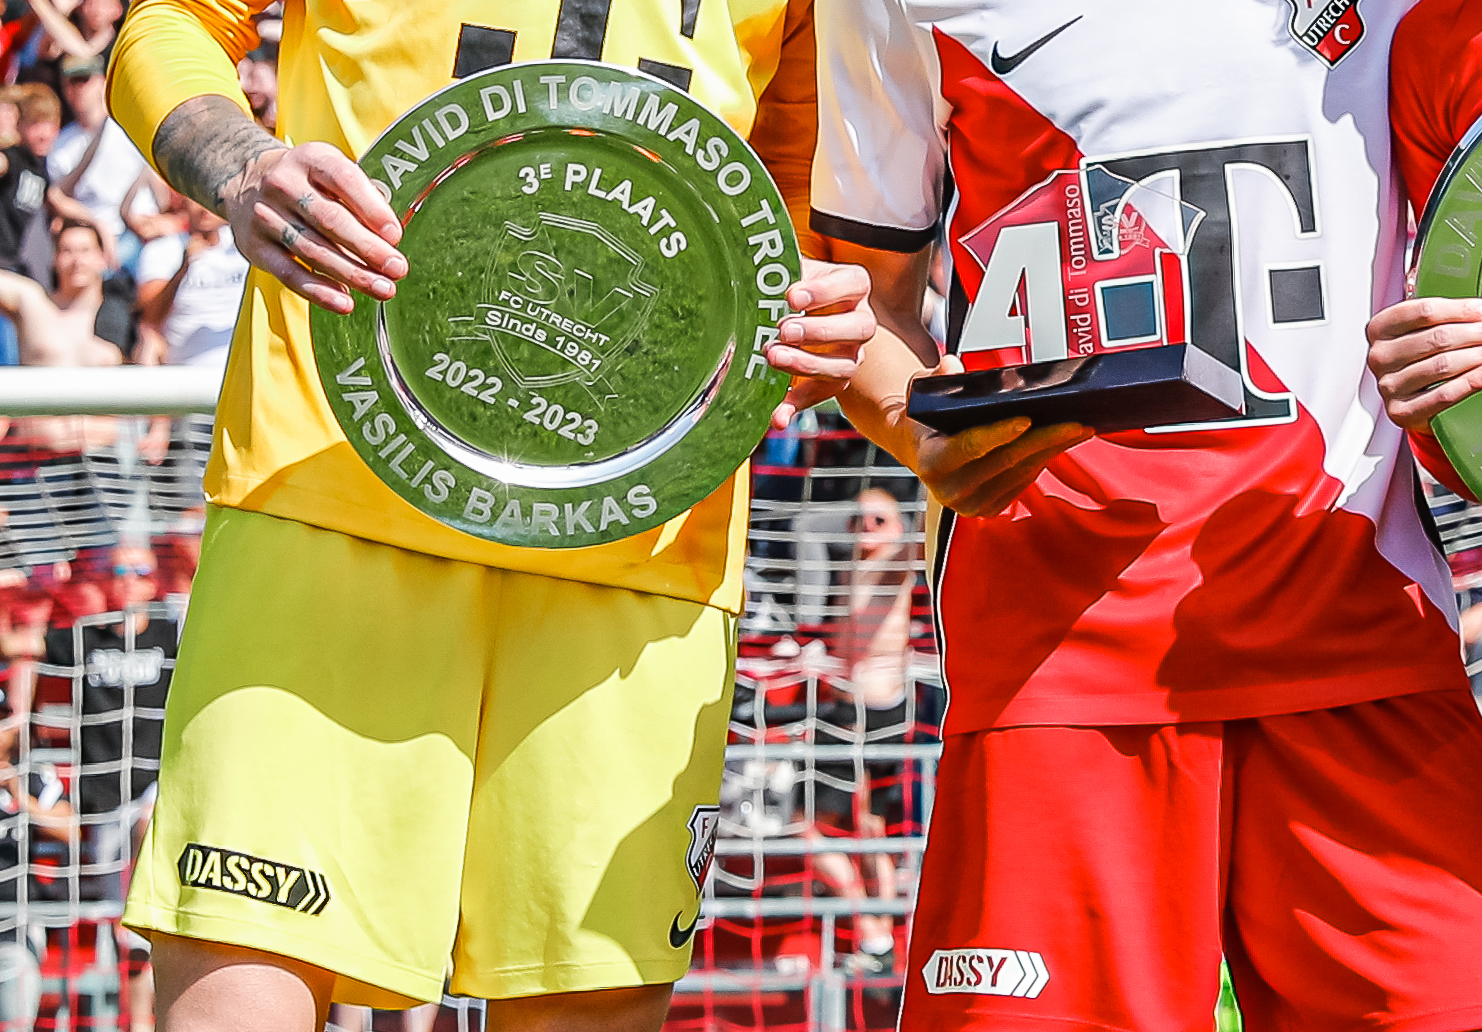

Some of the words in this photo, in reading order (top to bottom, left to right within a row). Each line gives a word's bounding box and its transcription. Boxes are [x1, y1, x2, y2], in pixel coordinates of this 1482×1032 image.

[1334, 24, 1351, 45] C
[479, 80, 527, 123] DI
[540, 74, 753, 197] TOMMASO
[564, 163, 688, 260] PLAATS
[1065, 184, 1087, 281] Tommaso
[498, 290, 524, 309] FC
[526, 302, 611, 347] UTRECHT
[1068, 287, 1090, 307] di
[484, 310, 548, 342] Sinds
[555, 336, 603, 373] 1981
[1070, 313, 1094, 357] avid
[424, 352, 504, 407] 2022
[523, 393, 600, 448] 2023
[335, 356, 456, 505] VASILIS
[463, 483, 658, 537] BARKAS
[701, 817, 710, 839] F
[185, 847, 301, 904] DASSY
